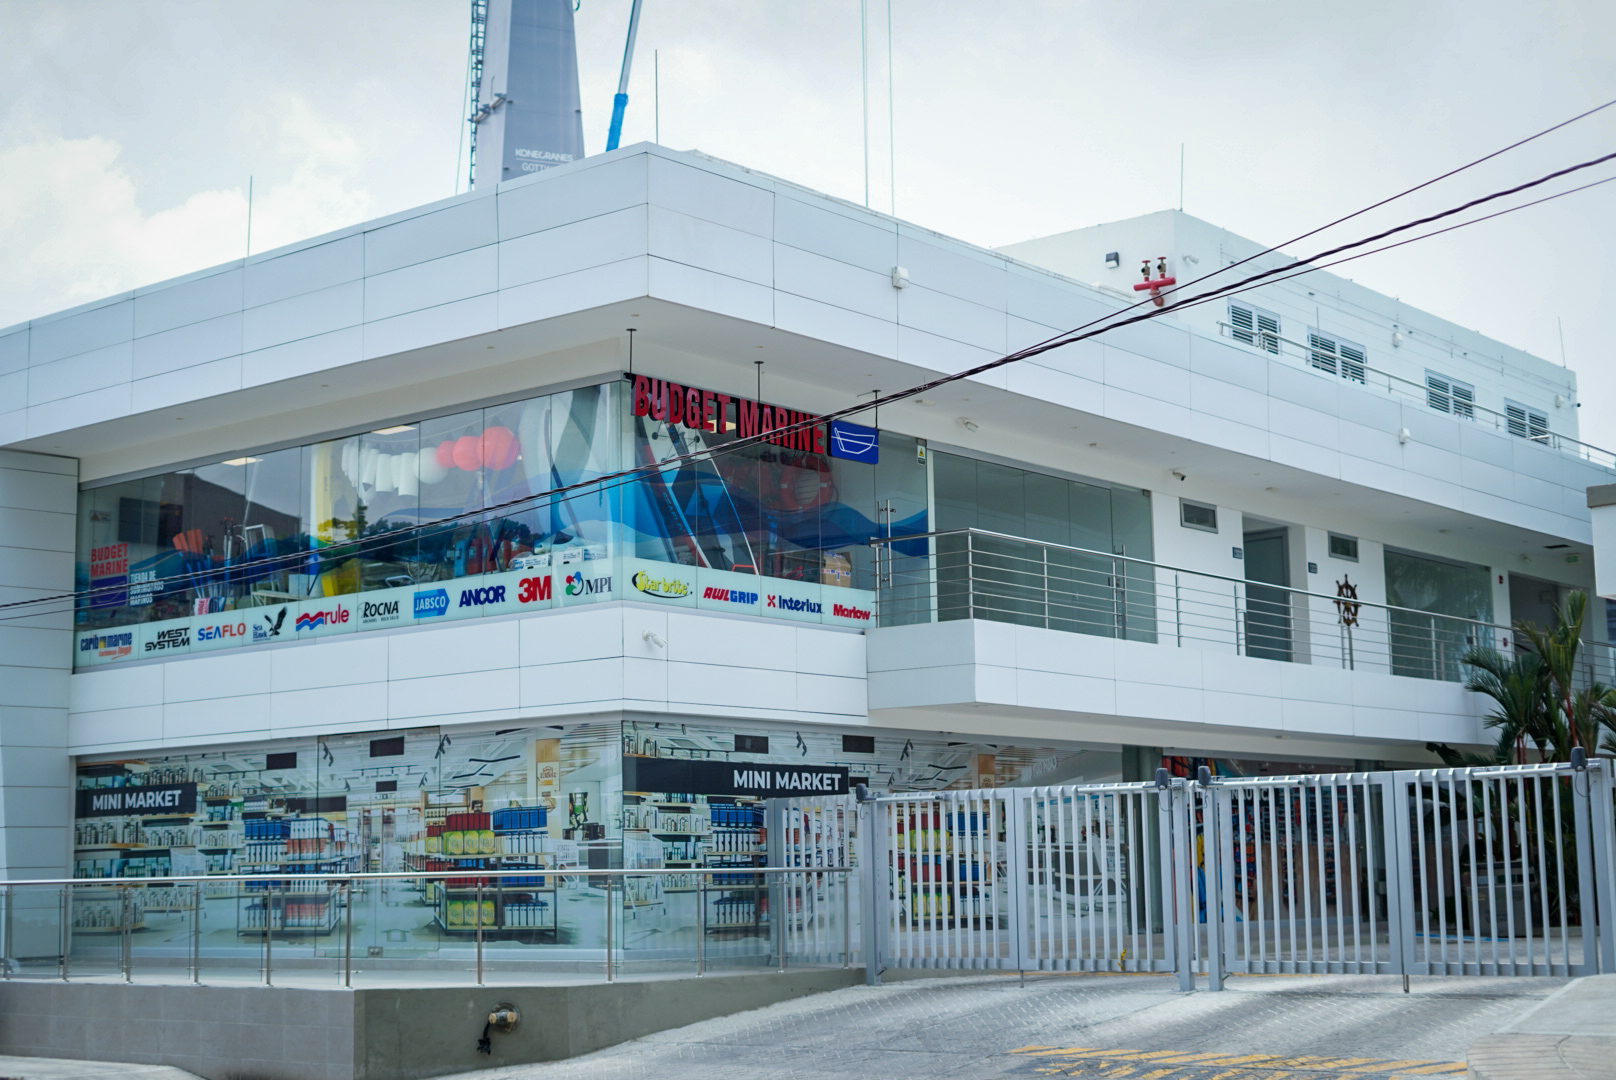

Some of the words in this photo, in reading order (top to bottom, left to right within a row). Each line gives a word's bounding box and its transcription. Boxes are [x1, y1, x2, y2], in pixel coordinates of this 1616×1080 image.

[515, 148, 573, 162] KONECRANES
[633, 374, 731, 434] BUDGET
[738, 398, 825, 454] MARINE
[91, 542, 129, 562] BUDGET
[91, 559, 129, 578] MARINE
[518, 575, 552, 603] 3M
[585, 576, 613, 595] MPI
[636, 571, 661, 592] Star
[662, 578, 689, 596] brite
[415, 595, 446, 611] JABSCO
[459, 585, 506, 607] ANCOR
[703, 587, 759, 605] AWLGRIP
[779, 595, 823, 614] Interlux
[324, 603, 349, 625] rule
[363, 600, 399, 618] ROCNA
[833, 604, 871, 620] Marlow
[157, 627, 190, 640] WEST
[198, 622, 247, 641] SEAFLO
[145, 637, 190, 652] SYSTEM
[734, 769, 771, 789] MINI
[776, 771, 841, 791] MARKET
[93, 794, 122, 811] MINI
[125, 789, 182, 809] MARKET
